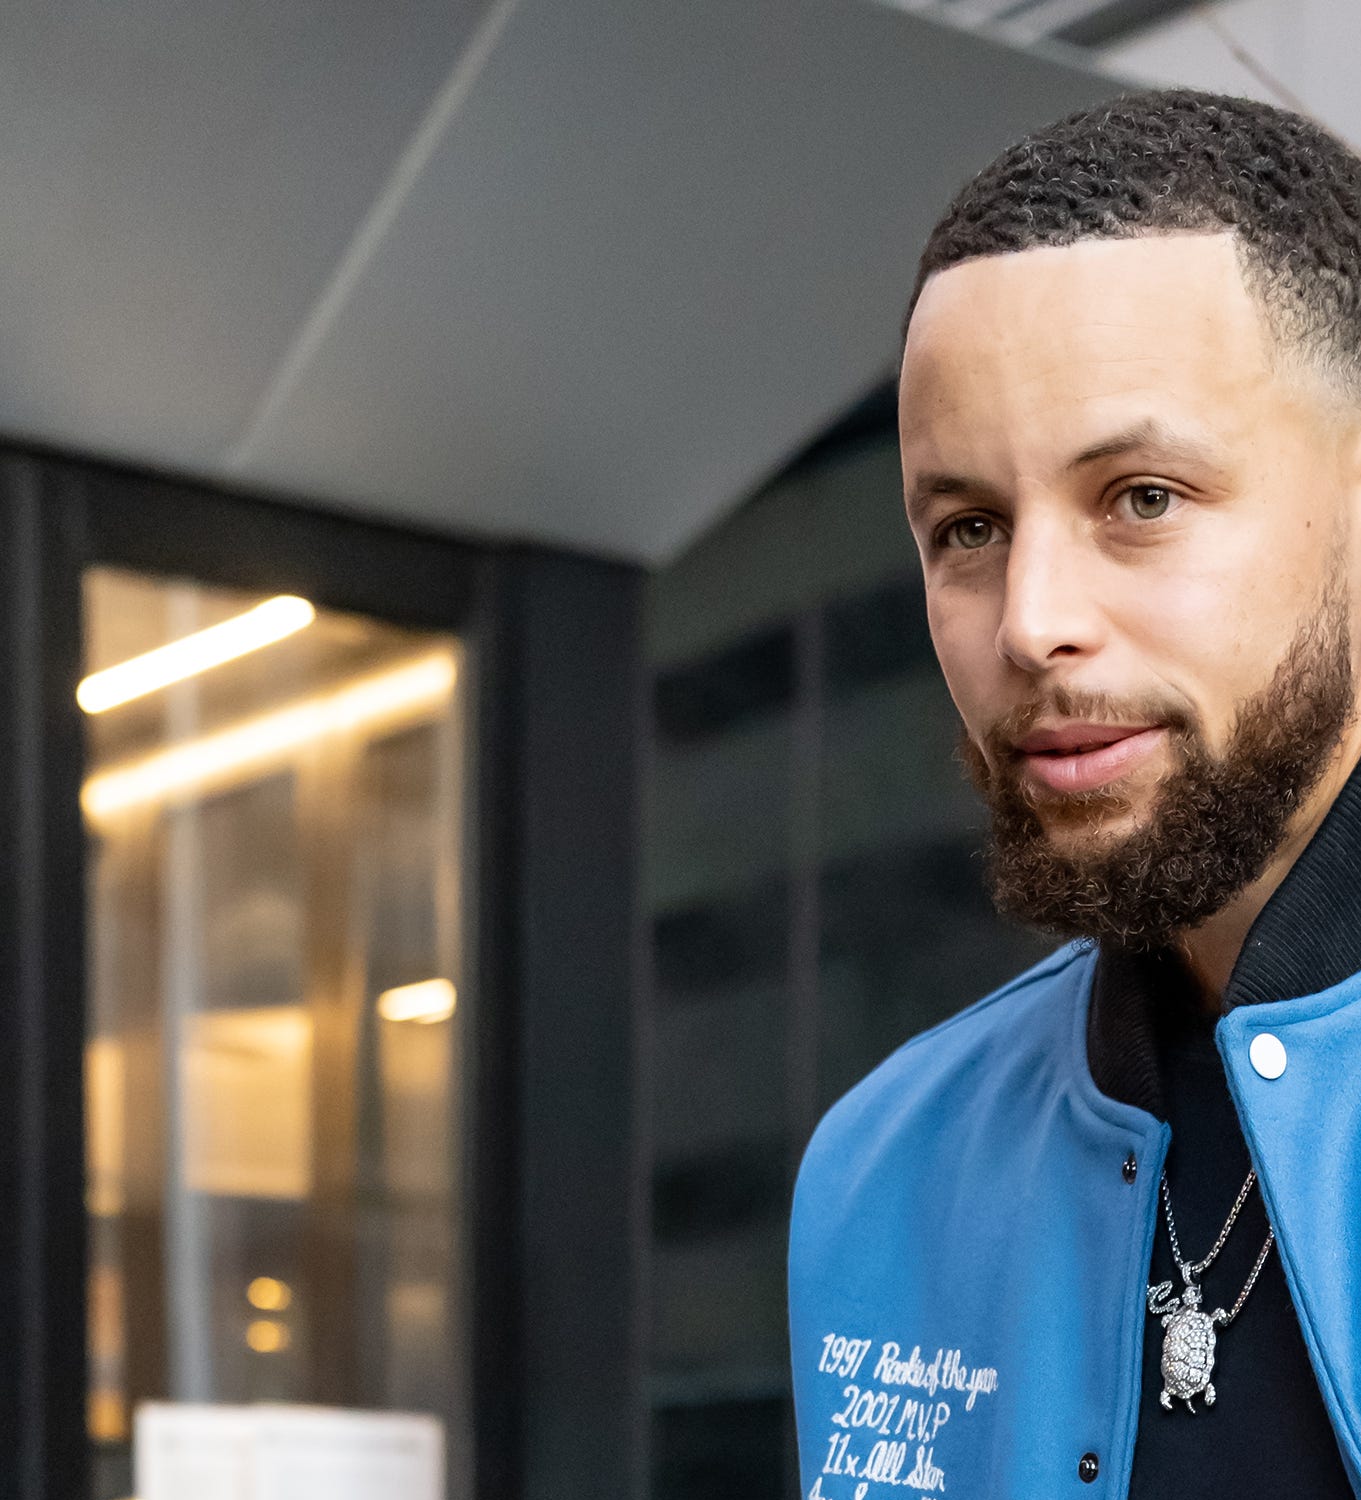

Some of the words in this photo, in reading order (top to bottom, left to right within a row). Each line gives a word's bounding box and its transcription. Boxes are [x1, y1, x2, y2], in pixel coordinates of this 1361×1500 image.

[818, 1333, 872, 1379] 1997
[873, 1341, 927, 1388] Rookie
[924, 1348, 943, 1397] of
[942, 1349, 967, 1391] the
[831, 1384, 900, 1435] 2001
[822, 1432, 860, 1477] 11x
[858, 1440, 907, 1486] All
[902, 1445, 945, 1492] Star
